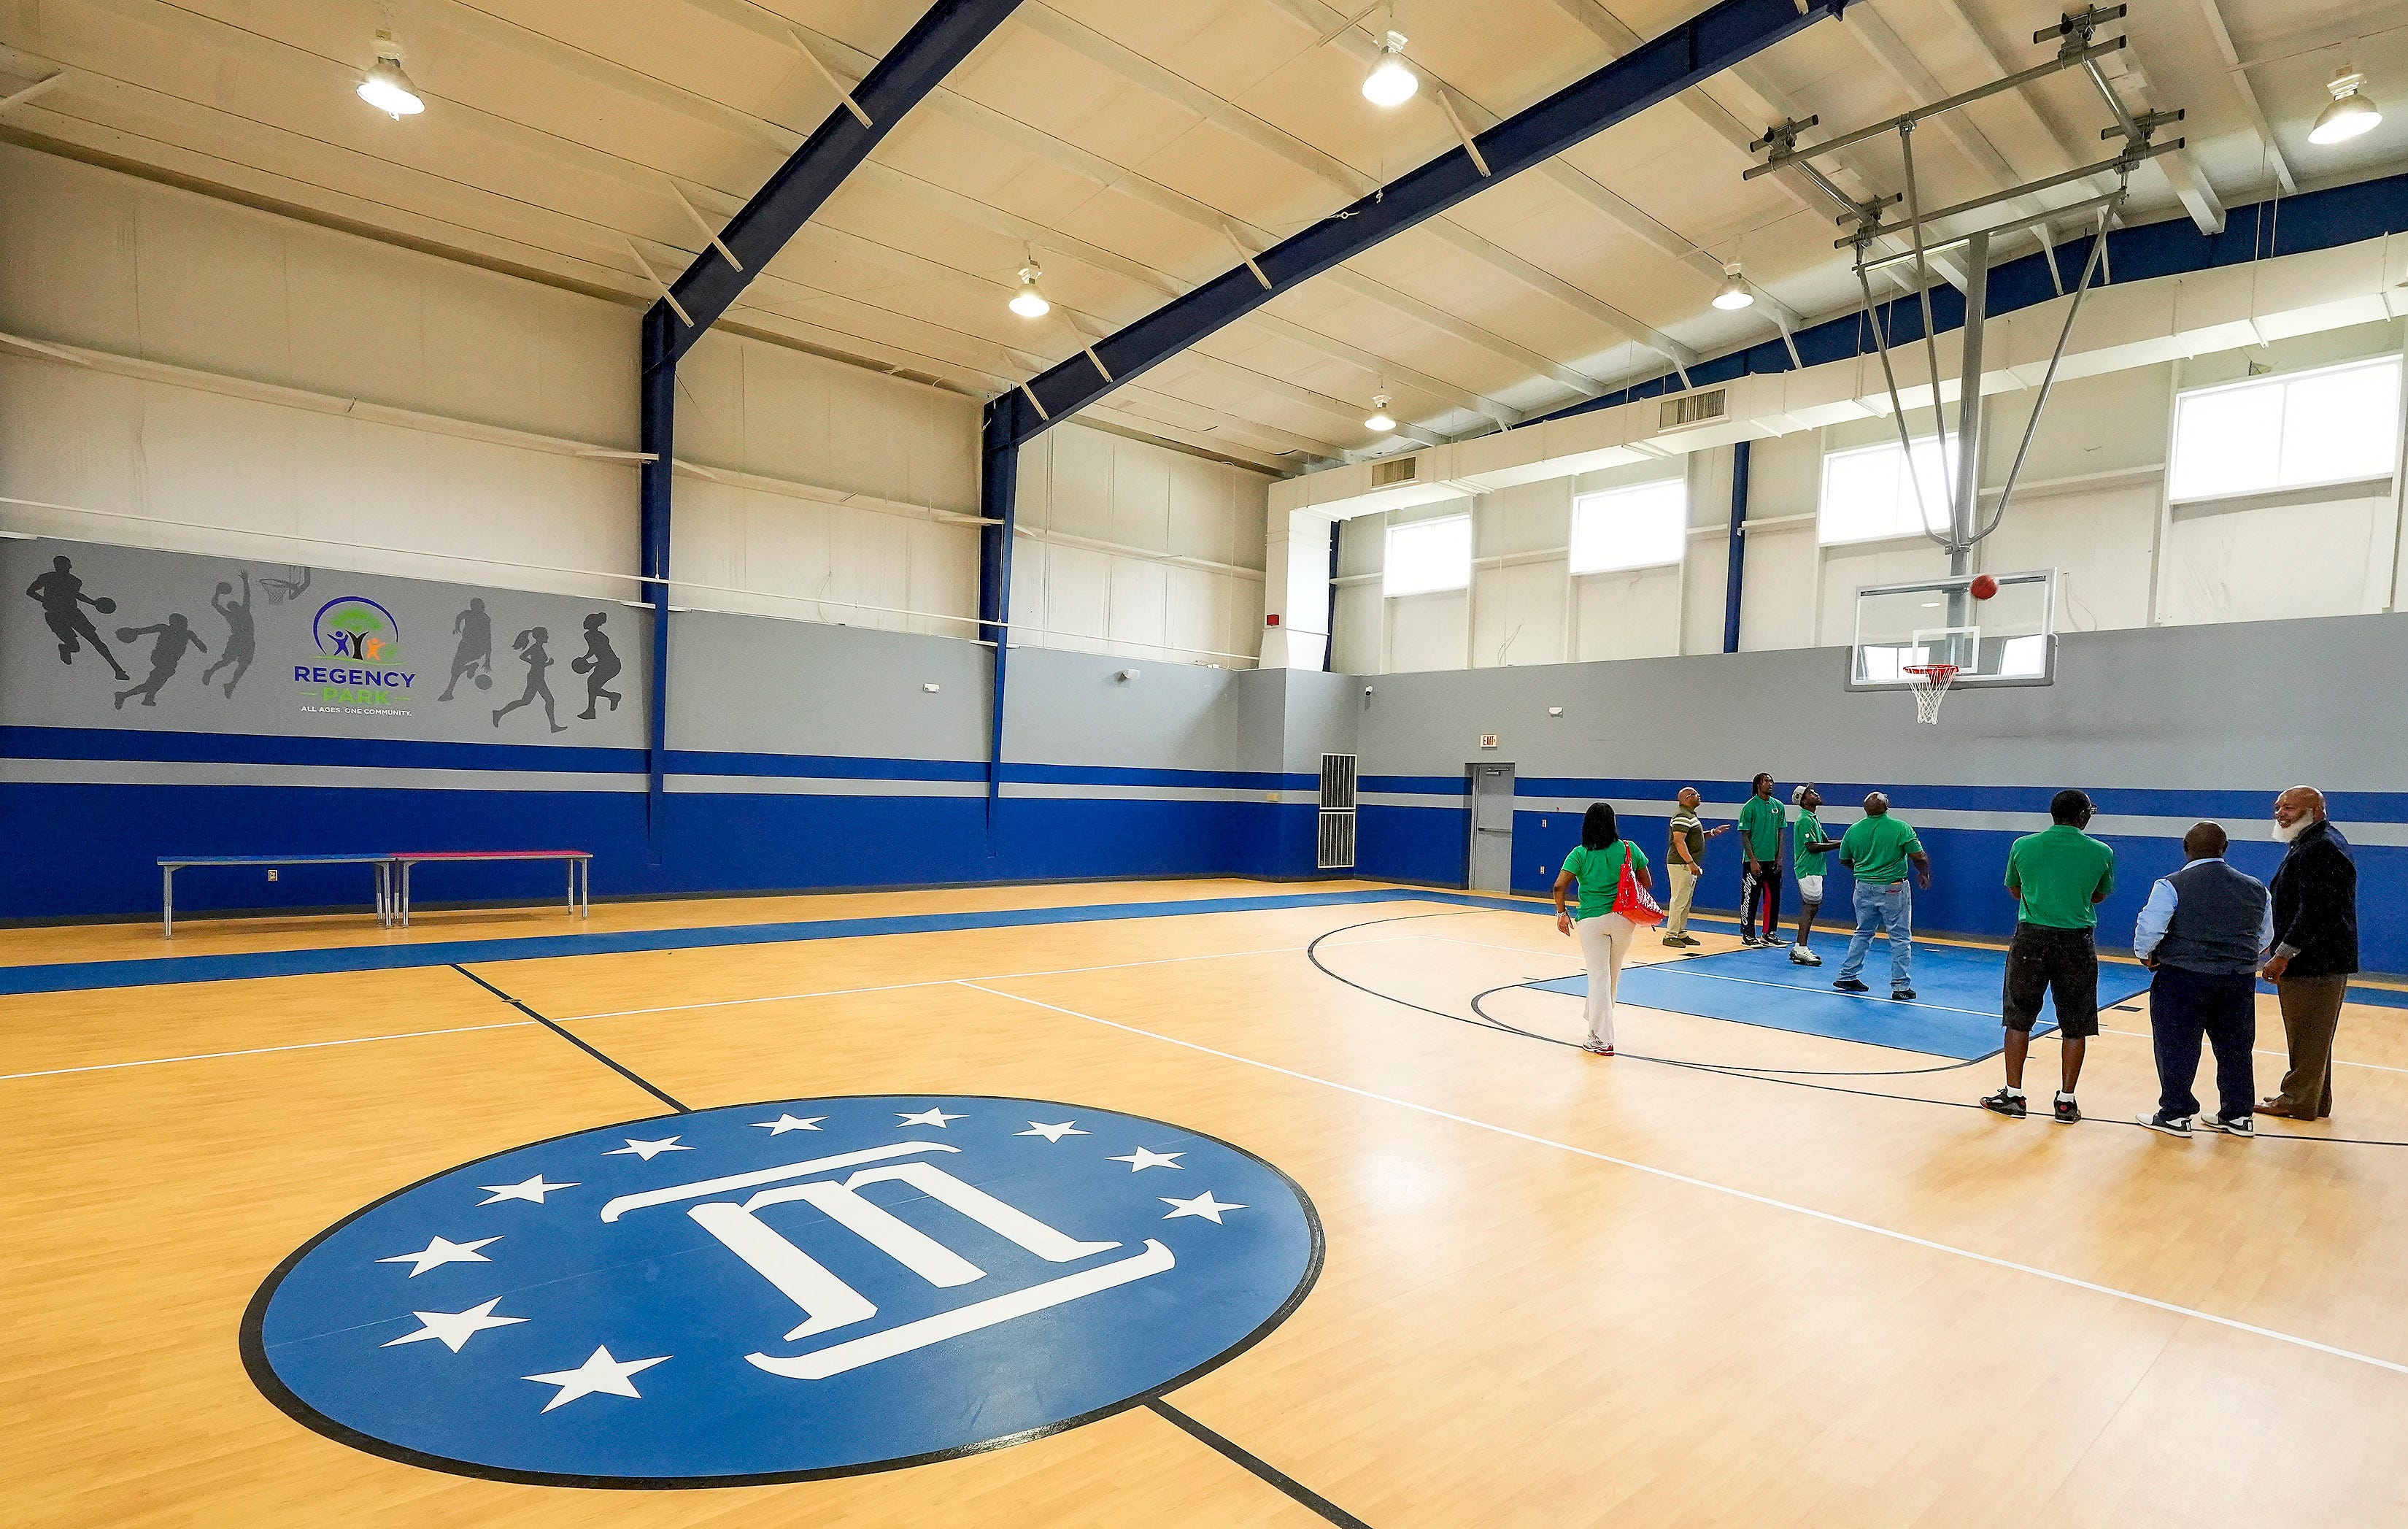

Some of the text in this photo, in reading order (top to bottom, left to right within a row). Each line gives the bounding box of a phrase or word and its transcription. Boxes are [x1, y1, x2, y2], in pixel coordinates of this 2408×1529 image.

[294, 666, 416, 688] REGENCY
[323, 686, 390, 706] PARK
[363, 708, 412, 717] COMMUNITY.
[1483, 736, 1494, 746] EXIT
